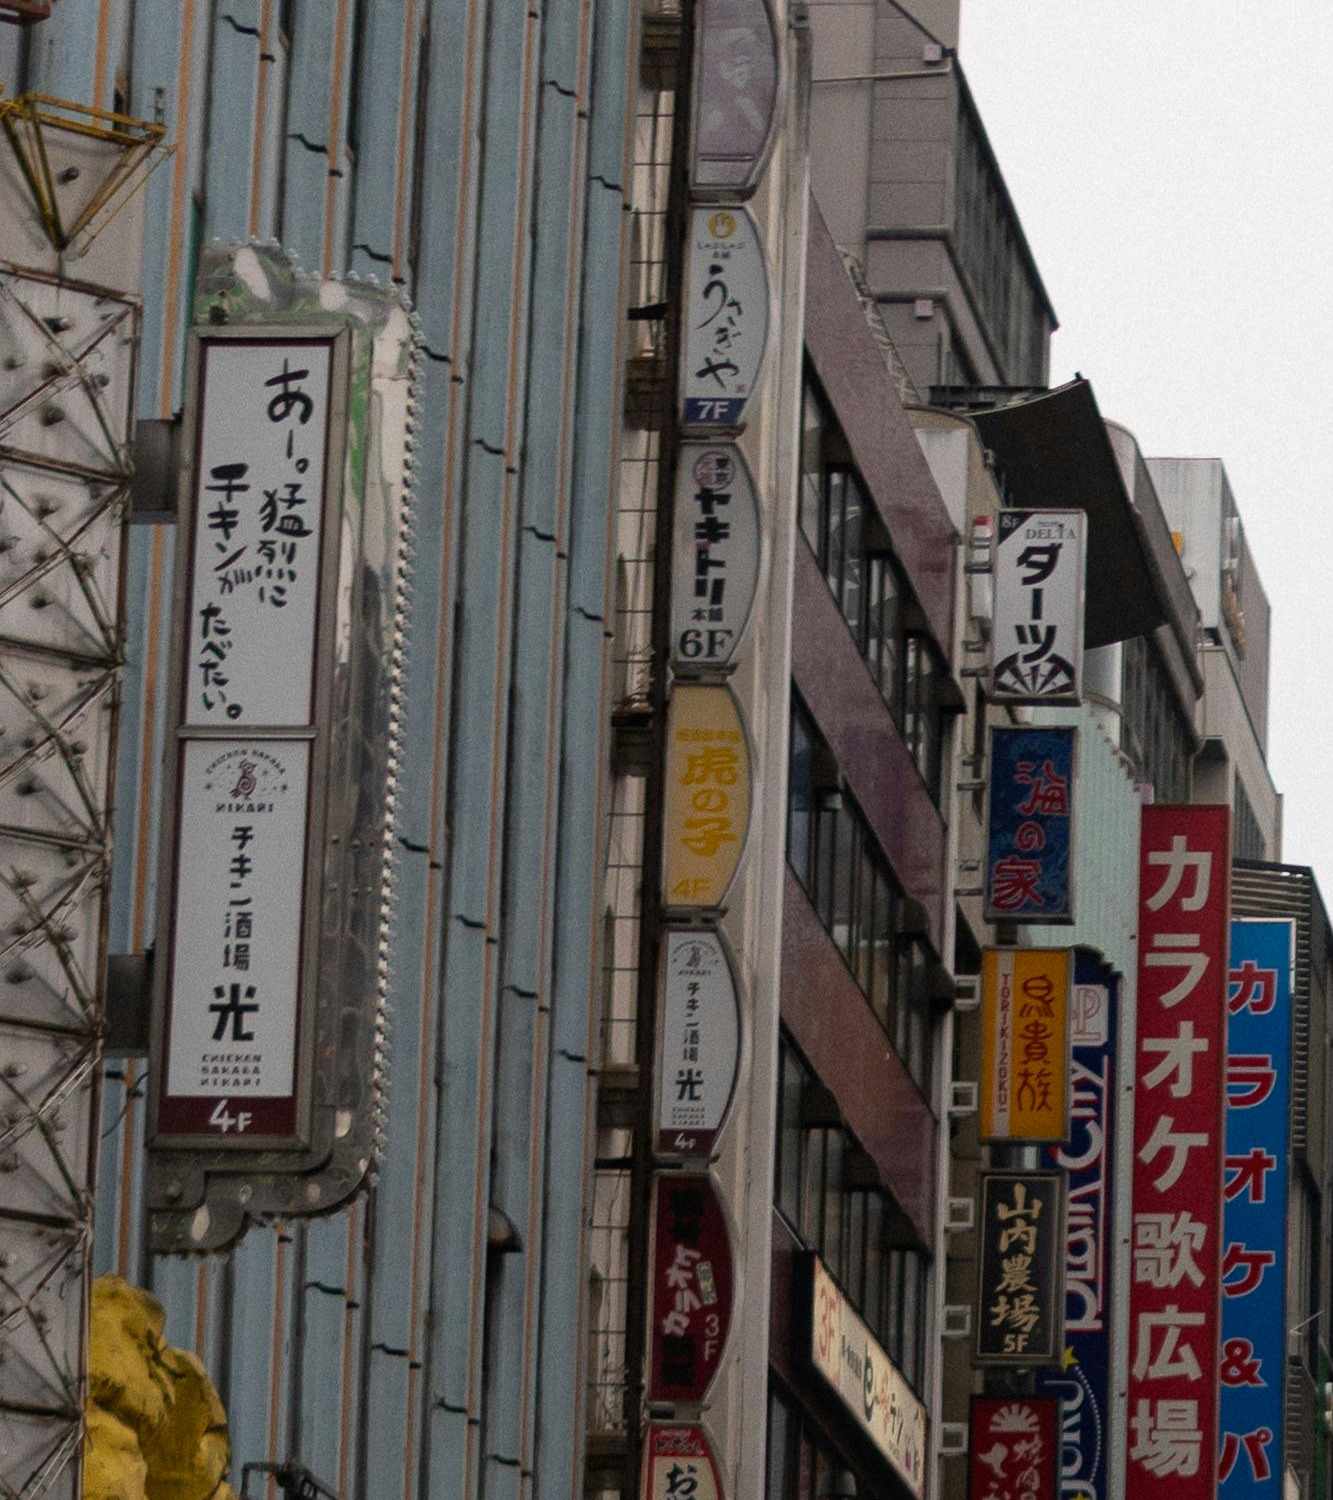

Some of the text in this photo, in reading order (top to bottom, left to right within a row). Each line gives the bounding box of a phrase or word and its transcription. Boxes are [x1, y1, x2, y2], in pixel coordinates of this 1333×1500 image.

[697, 401, 729, 421] 7F
[1025, 525, 1077, 541] DELTA
[1015, 542, 1064, 663] ダーツ
[679, 628, 733, 659] 6F
[680, 746, 739, 859] 虎の子
[991, 758, 1070, 913] 海の家
[222, 825, 255, 972] チキン酒場
[208, 982, 260, 1043] 光
[675, 1069, 704, 1102] 光
[208, 1100, 254, 1134] 4F
[1131, 835, 1213, 1479] カラオケ歌広場
[992, 1182, 1041, 1333] 山内農場
[1004, 1334, 1029, 1354] 5F
